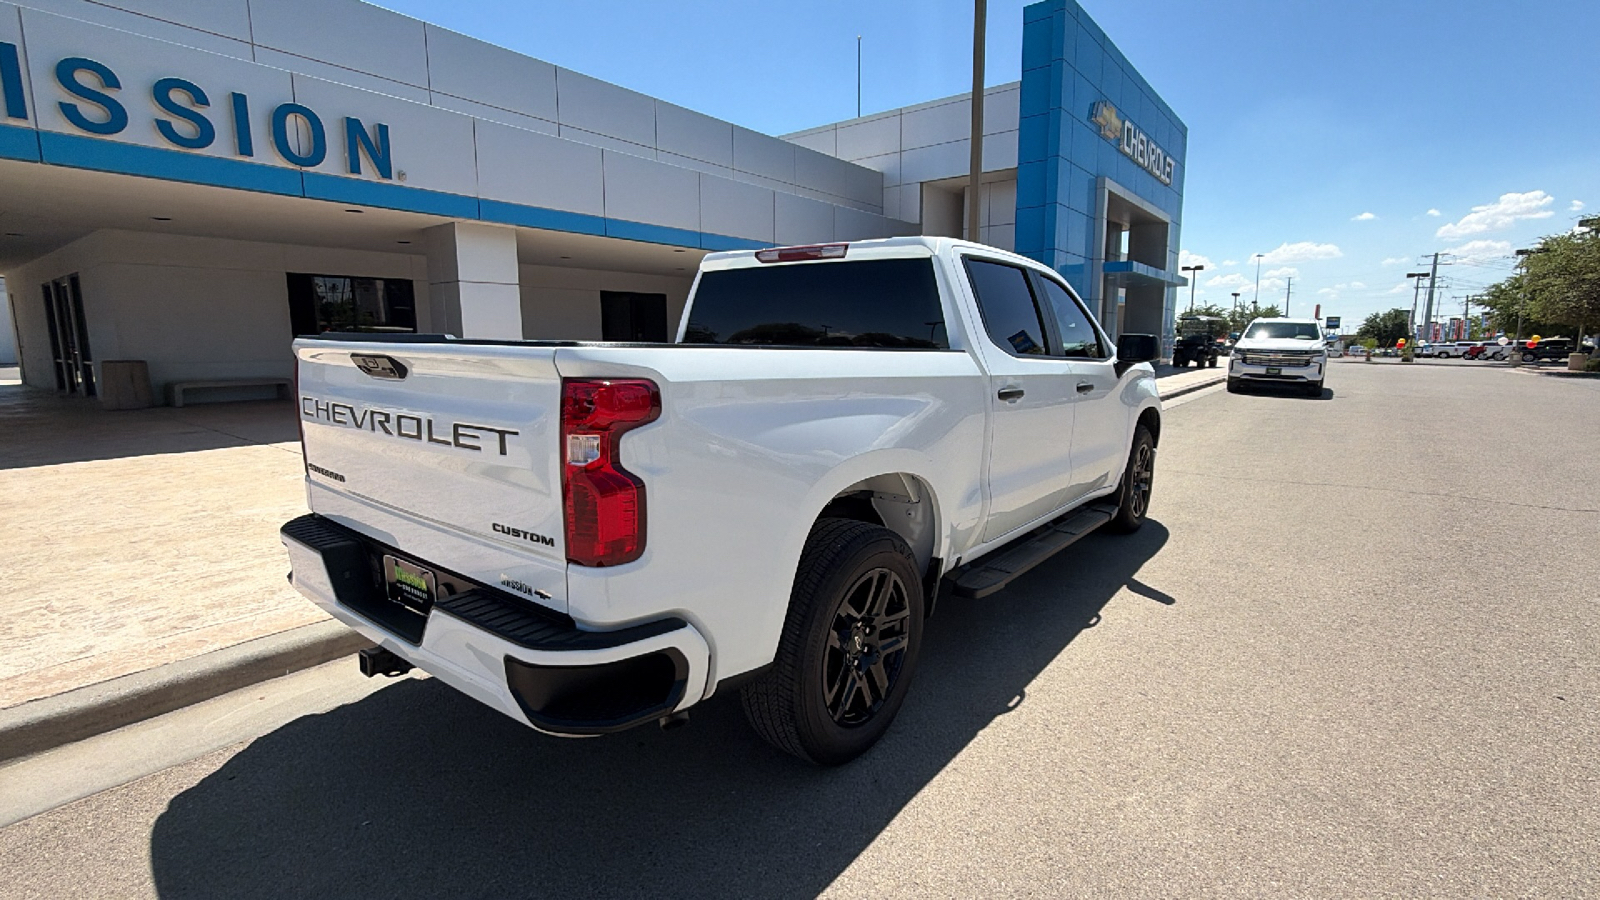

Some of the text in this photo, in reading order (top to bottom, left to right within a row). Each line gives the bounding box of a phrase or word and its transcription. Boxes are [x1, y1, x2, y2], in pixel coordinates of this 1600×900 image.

[1123, 120, 1175, 185] CHEVROLET
[302, 396, 519, 455] CHEVROLET
[492, 523, 555, 547] CUSTOM
